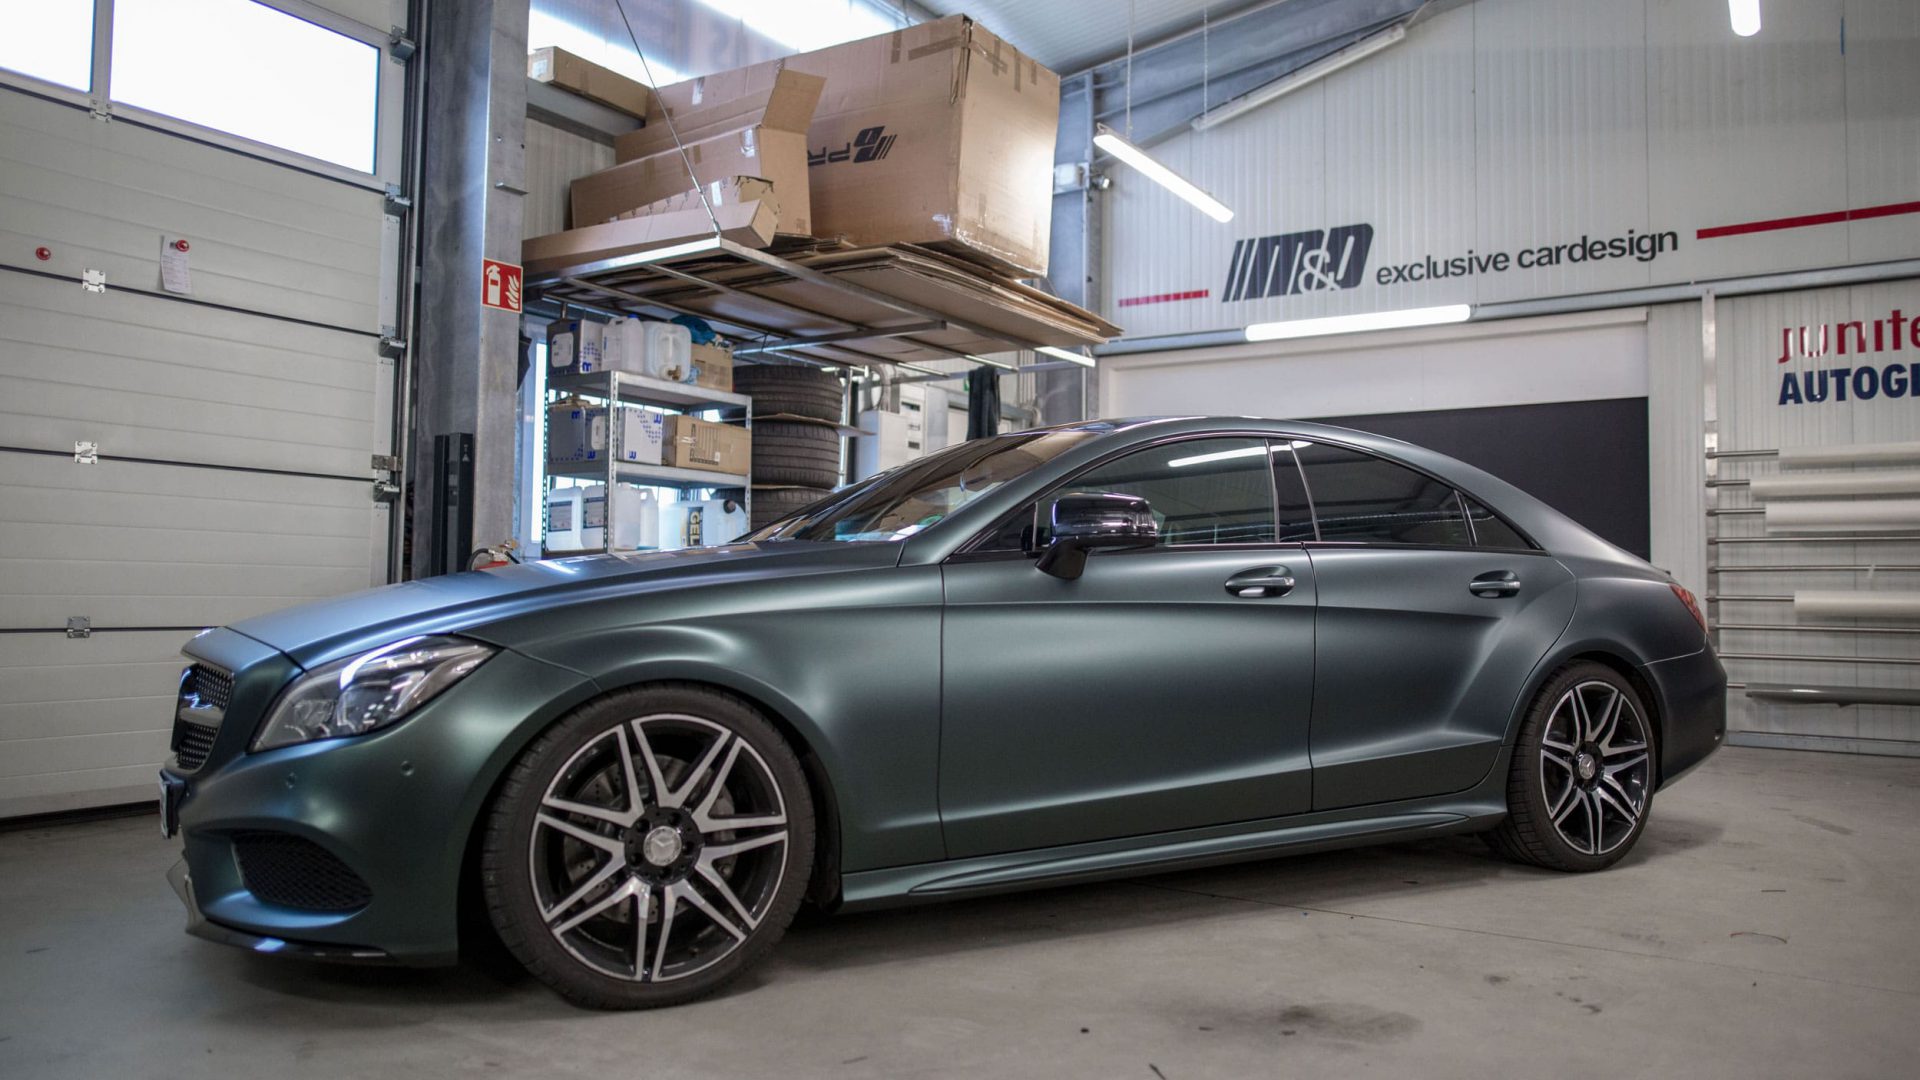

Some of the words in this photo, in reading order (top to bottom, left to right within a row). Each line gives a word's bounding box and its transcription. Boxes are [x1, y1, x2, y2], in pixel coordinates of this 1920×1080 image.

[1376, 250, 1510, 285] exclusive
[1517, 229, 1678, 262] cardesign
[689, 511, 700, 545] GEL
